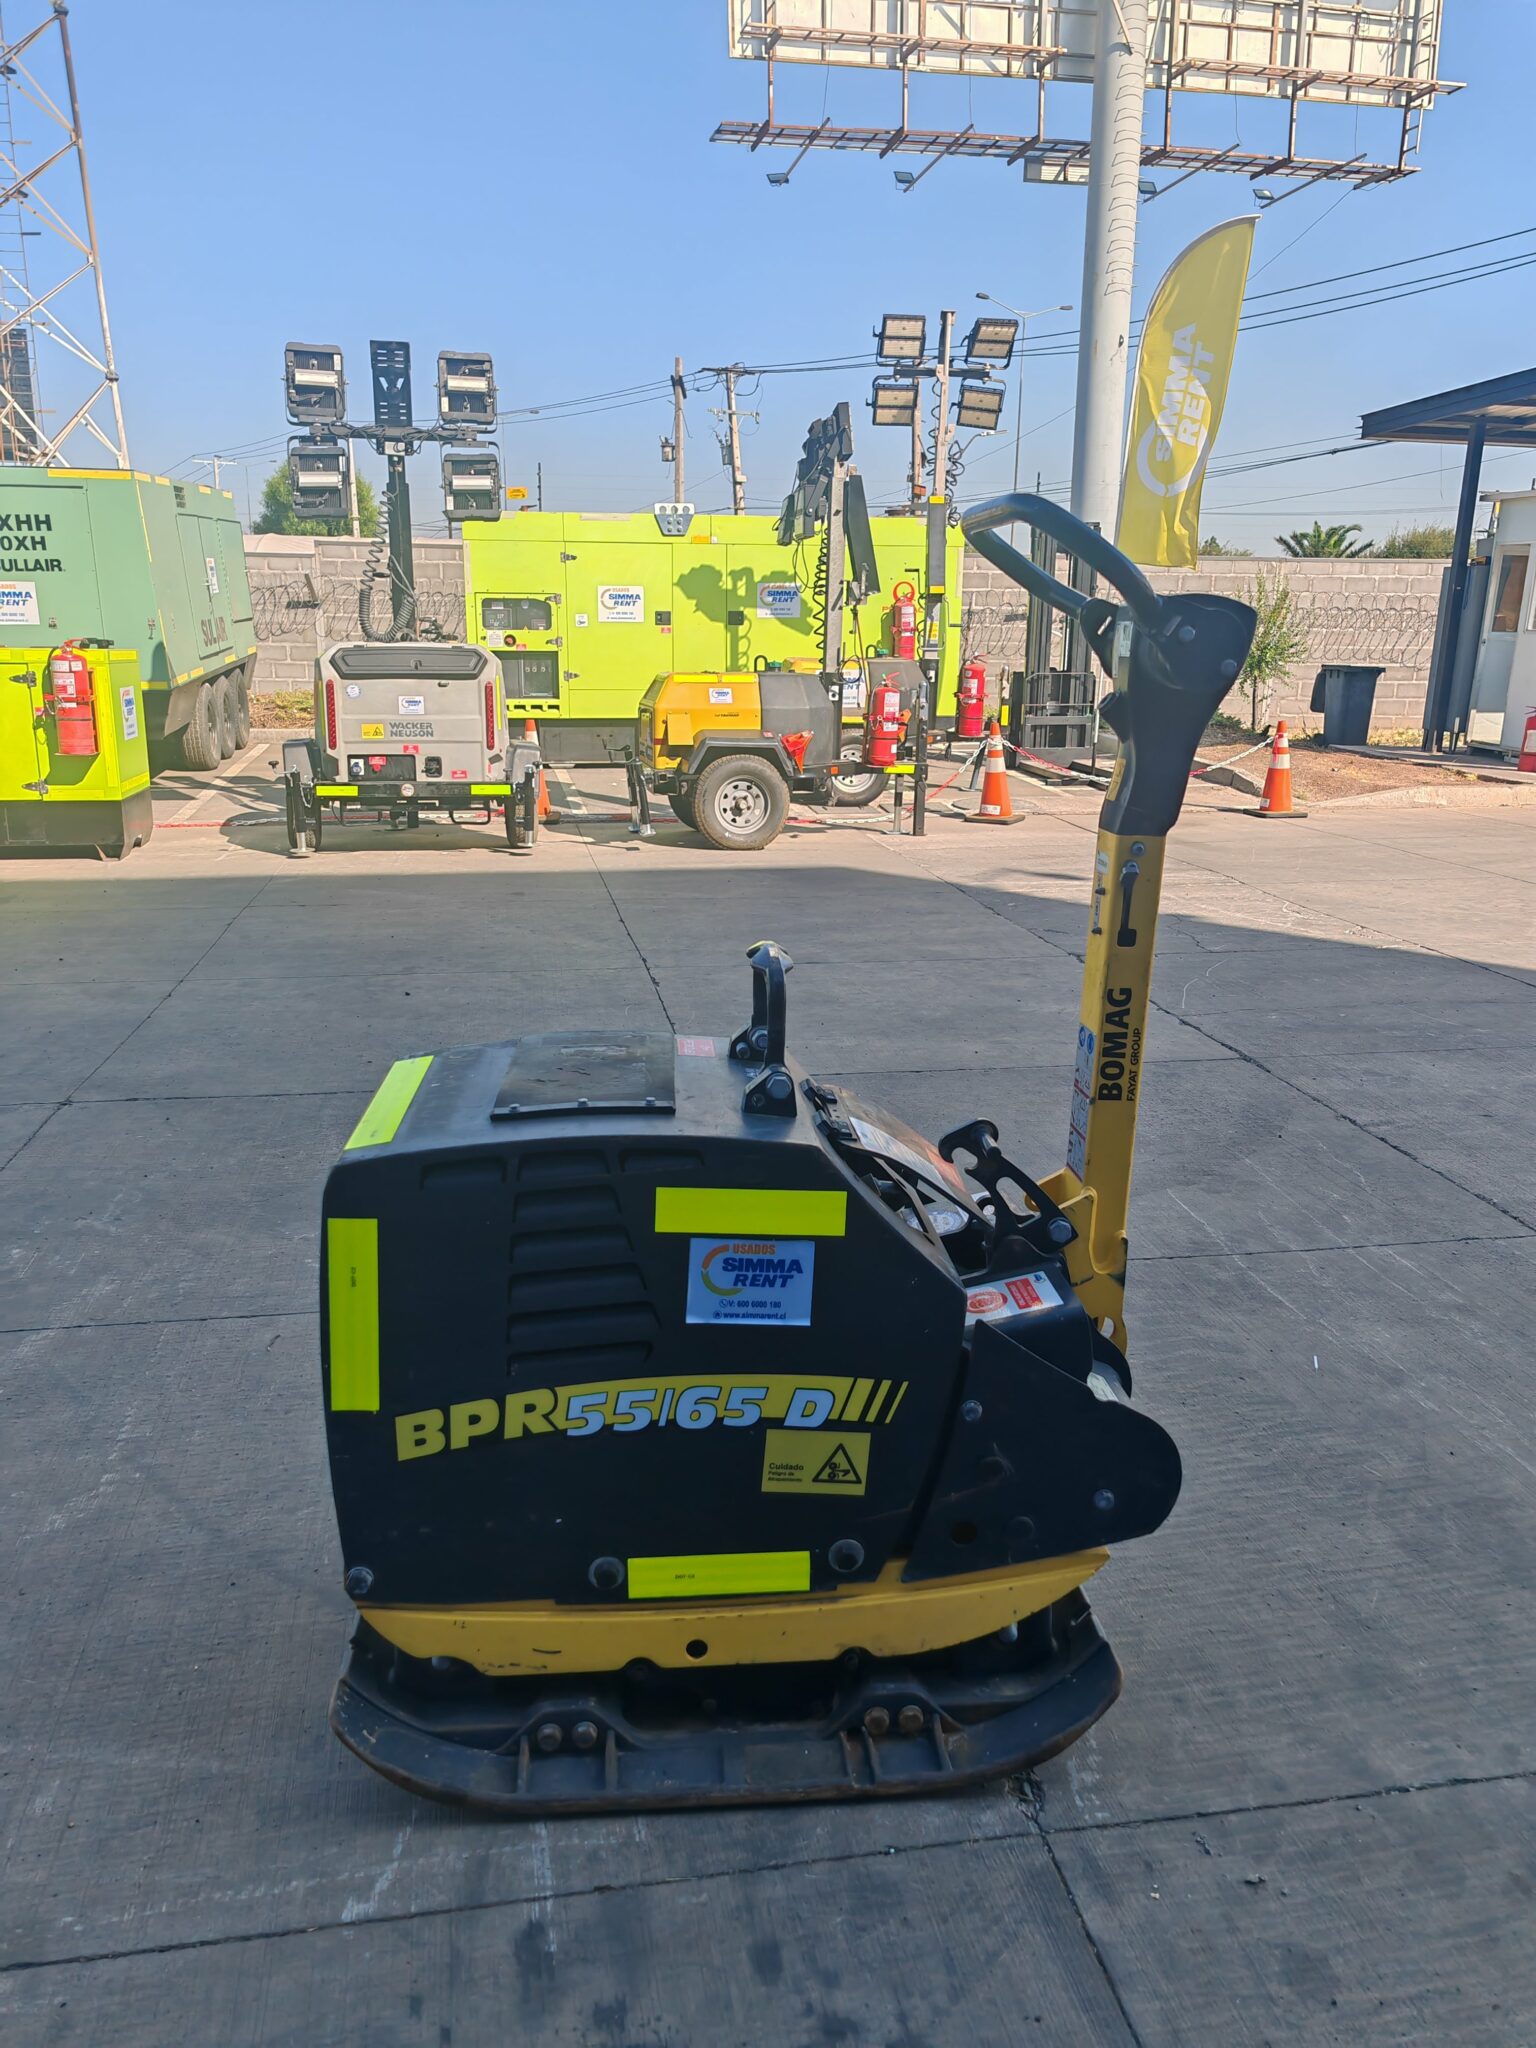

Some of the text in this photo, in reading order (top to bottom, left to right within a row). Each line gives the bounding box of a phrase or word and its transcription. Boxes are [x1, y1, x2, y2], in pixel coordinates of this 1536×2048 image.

[1155, 323, 1196, 462] SIMMA
[1176, 342, 1215, 446] RENT
[0, 559, 62, 572] ULLAIR
[0, 591, 33, 599] MMA
[1098, 987, 1132, 1101] BOMAG
[1127, 1027, 1142, 1101] FAYAT GROUP
[733, 1243, 776, 1255] USADOS
[722, 1257, 804, 1274] SIMMA
[733, 1274, 795, 1288] RENT
[723, 1311, 787, 1320] www.simmarent.cl
[784, 1387, 836, 1428] D
[769, 1462, 804, 1471] Cuidado
